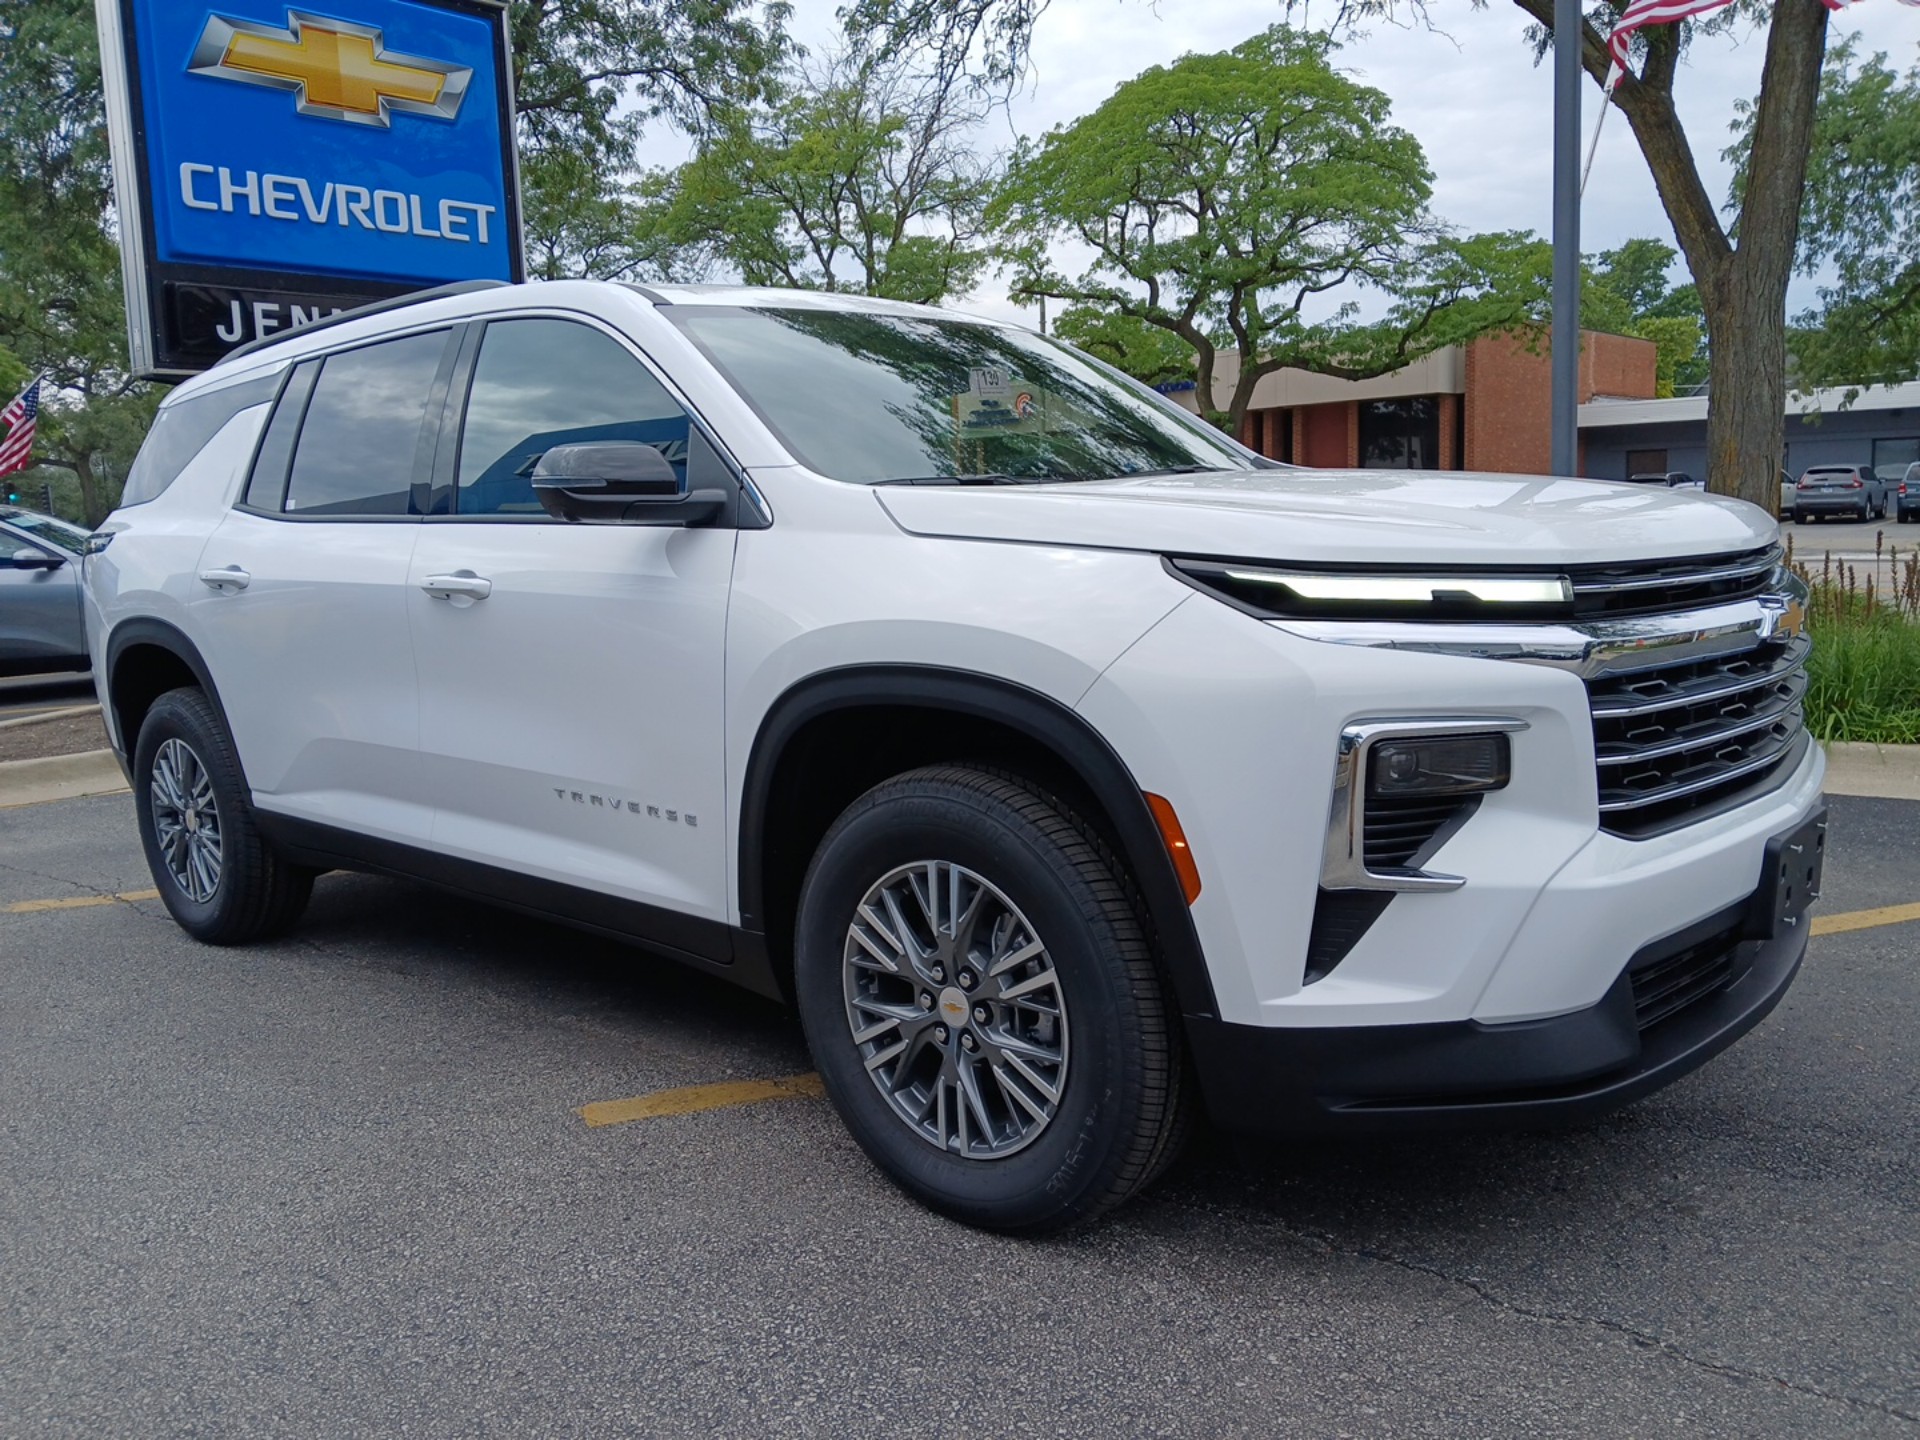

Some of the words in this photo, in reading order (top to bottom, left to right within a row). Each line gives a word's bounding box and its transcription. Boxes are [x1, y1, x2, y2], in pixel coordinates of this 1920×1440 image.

[180, 162, 495, 243] CHEVROLET
[216, 300, 343, 342] JEN
[552, 788, 698, 827] TRAVERSE
